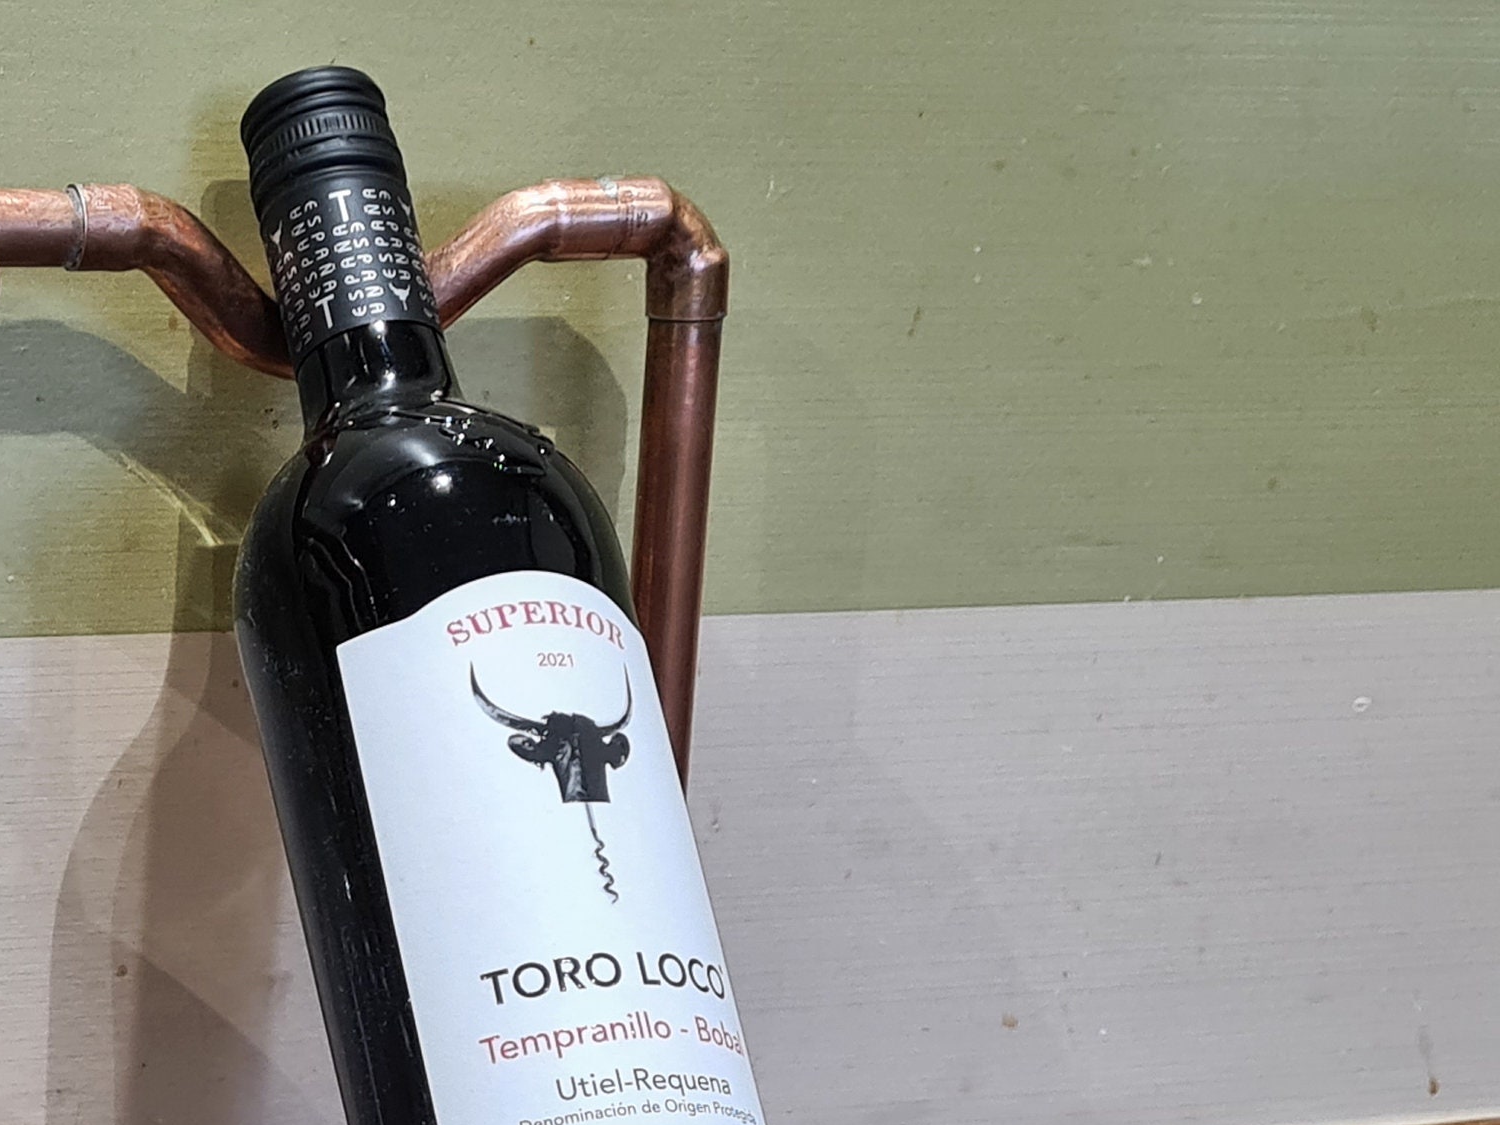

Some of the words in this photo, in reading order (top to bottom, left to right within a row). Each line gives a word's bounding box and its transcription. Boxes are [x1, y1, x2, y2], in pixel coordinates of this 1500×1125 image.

[446, 600, 625, 650] SUPERIOR
[537, 652, 574, 668] 2021
[479, 952, 623, 1005] TORO
[636, 951, 725, 1000] LOCO
[478, 1010, 672, 1064] Tempranillo
[555, 1068, 732, 1102] Utiel-Requena
[641, 1098, 661, 1114] de
[664, 1098, 711, 1117] Origen
